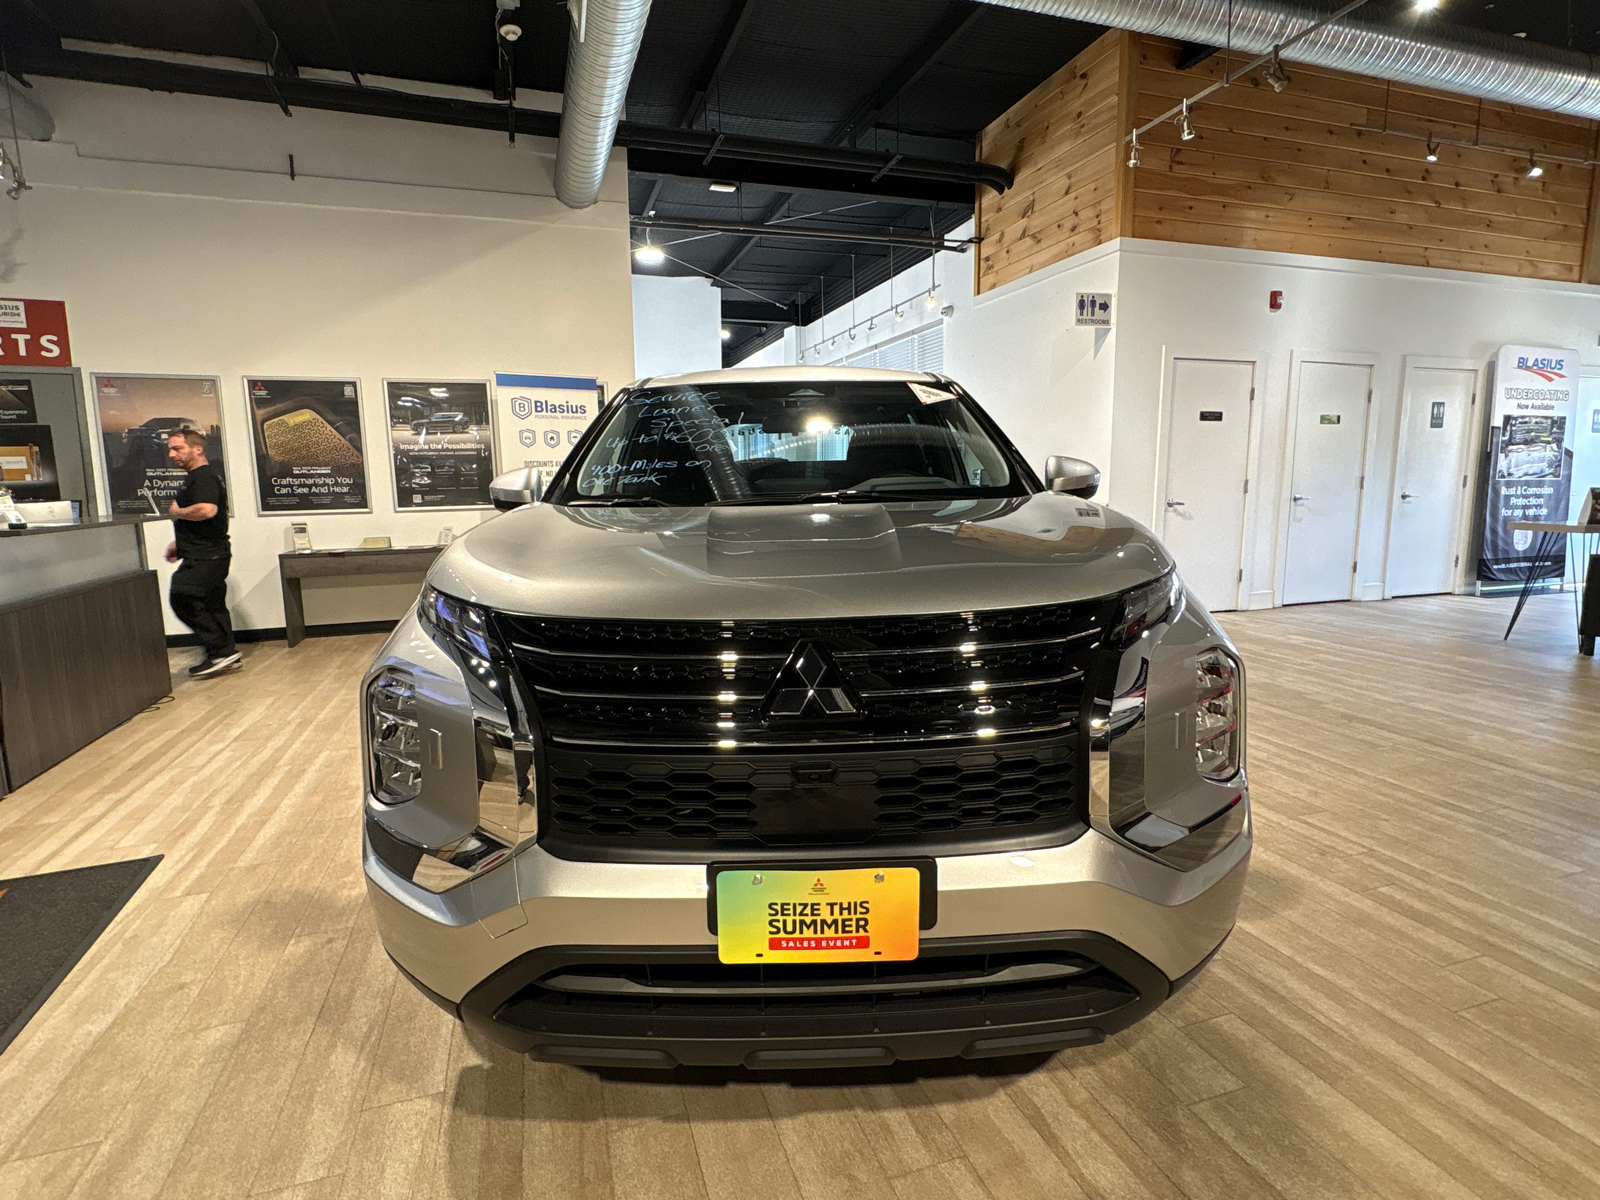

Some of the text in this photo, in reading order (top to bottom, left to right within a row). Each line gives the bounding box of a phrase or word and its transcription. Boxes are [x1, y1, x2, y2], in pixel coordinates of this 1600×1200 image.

[1517, 356, 1565, 371] BLASIUS
[1504, 387, 1570, 401] UNDERCOATING
[533, 400, 587, 415] Blasius
[1516, 402, 1555, 411] Now Available
[143, 479, 151, 487] A
[271, 476, 354, 485] Craftsmanship You
[293, 486, 309, 494] See
[1501, 486, 1516, 495] Rust
[1521, 486, 1554, 495] Corrosion
[1510, 497, 1544, 506] Protection
[1501, 506, 1548, 518] for any vehicle
[768, 900, 870, 917] SEIZE THIS
[768, 917, 869, 935] SUMMER
[821, 938, 857, 947] EVENT
